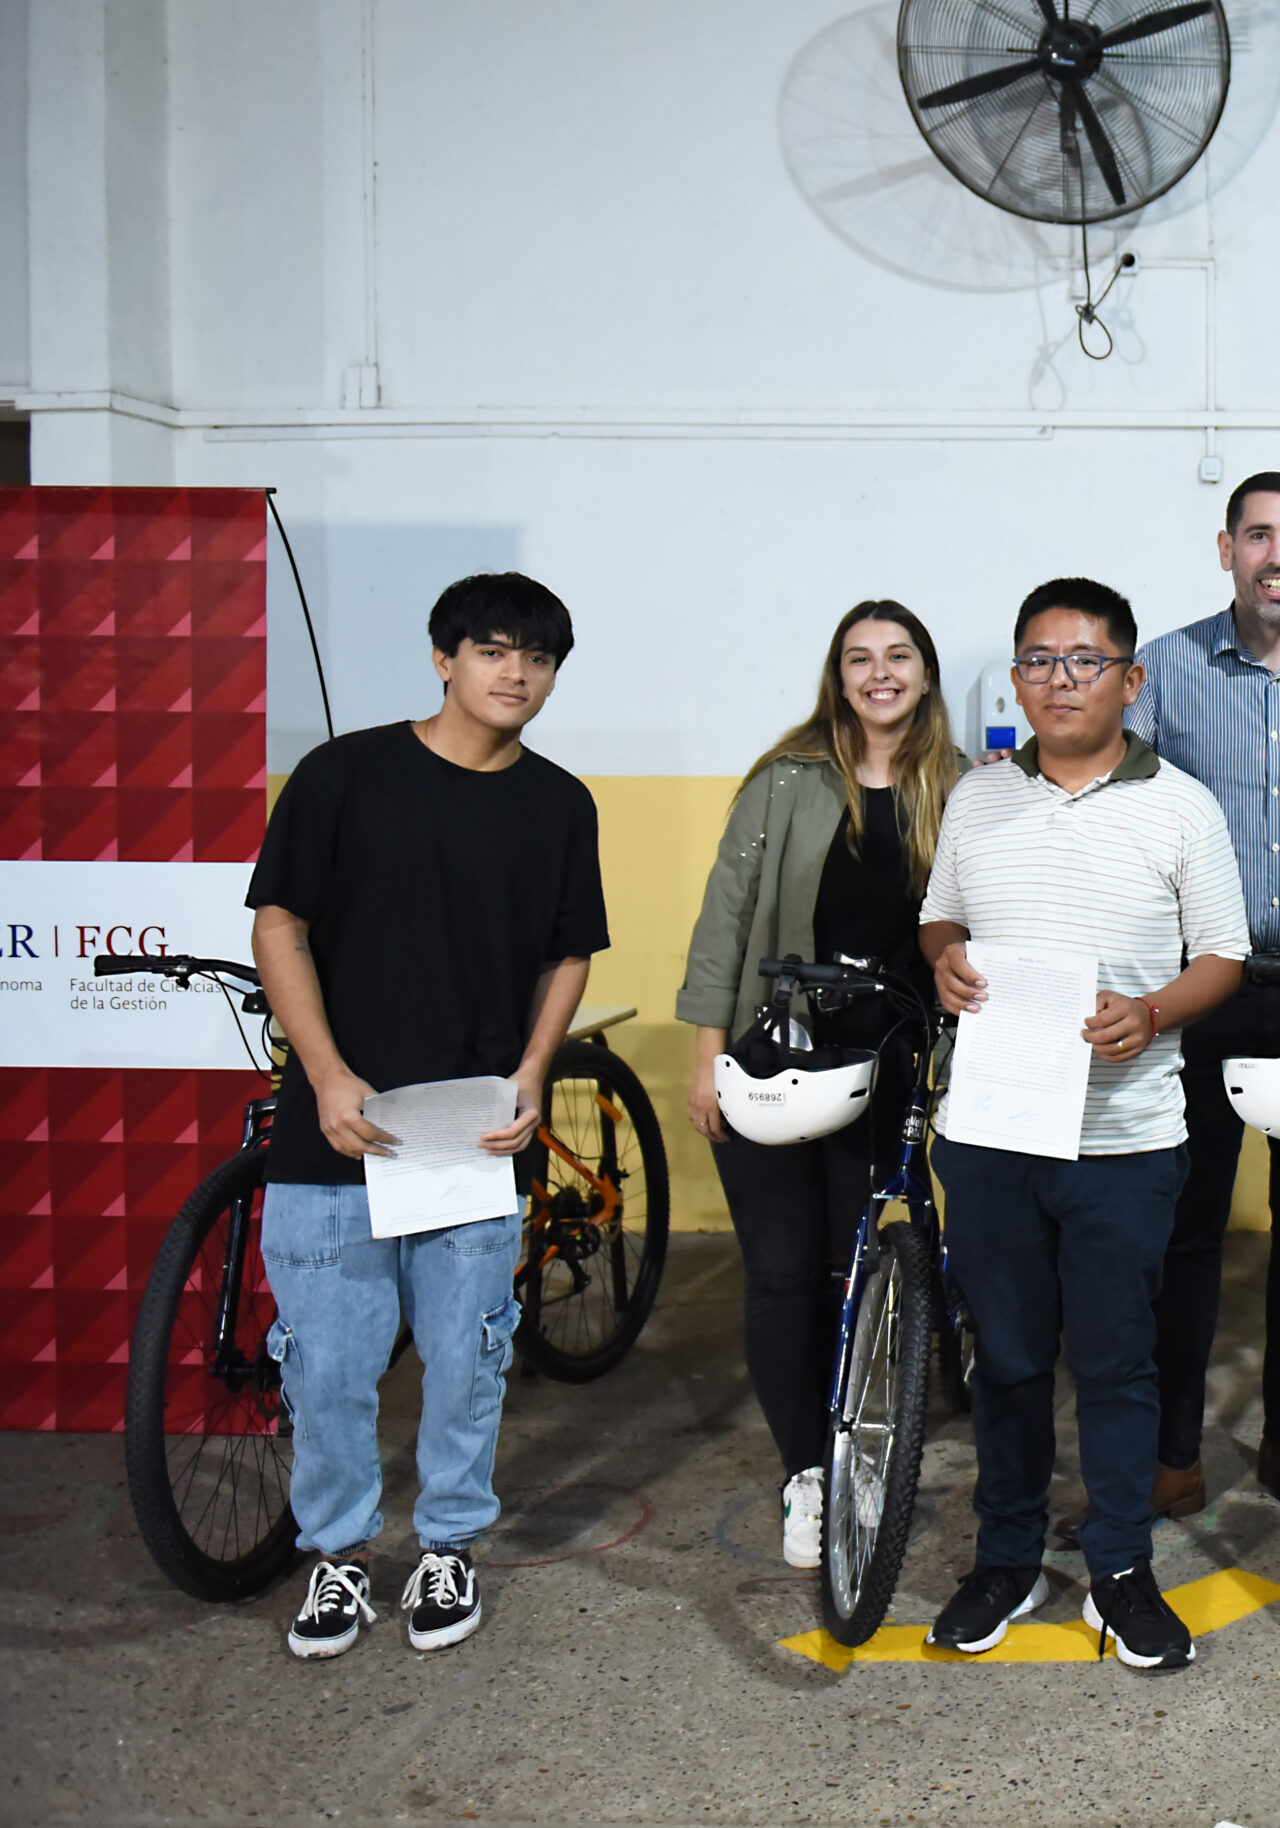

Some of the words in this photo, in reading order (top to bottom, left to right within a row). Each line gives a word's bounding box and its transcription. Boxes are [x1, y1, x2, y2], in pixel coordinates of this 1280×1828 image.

[76, 926, 169, 958] FCG
[70, 978, 132, 992] Facultad
[138, 979, 155, 992] de
[70, 996, 88, 1009] de
[93, 996, 105, 1009] la
[110, 996, 167, 1010] Gestión
[748, 1092, 782, 1102] 268959
